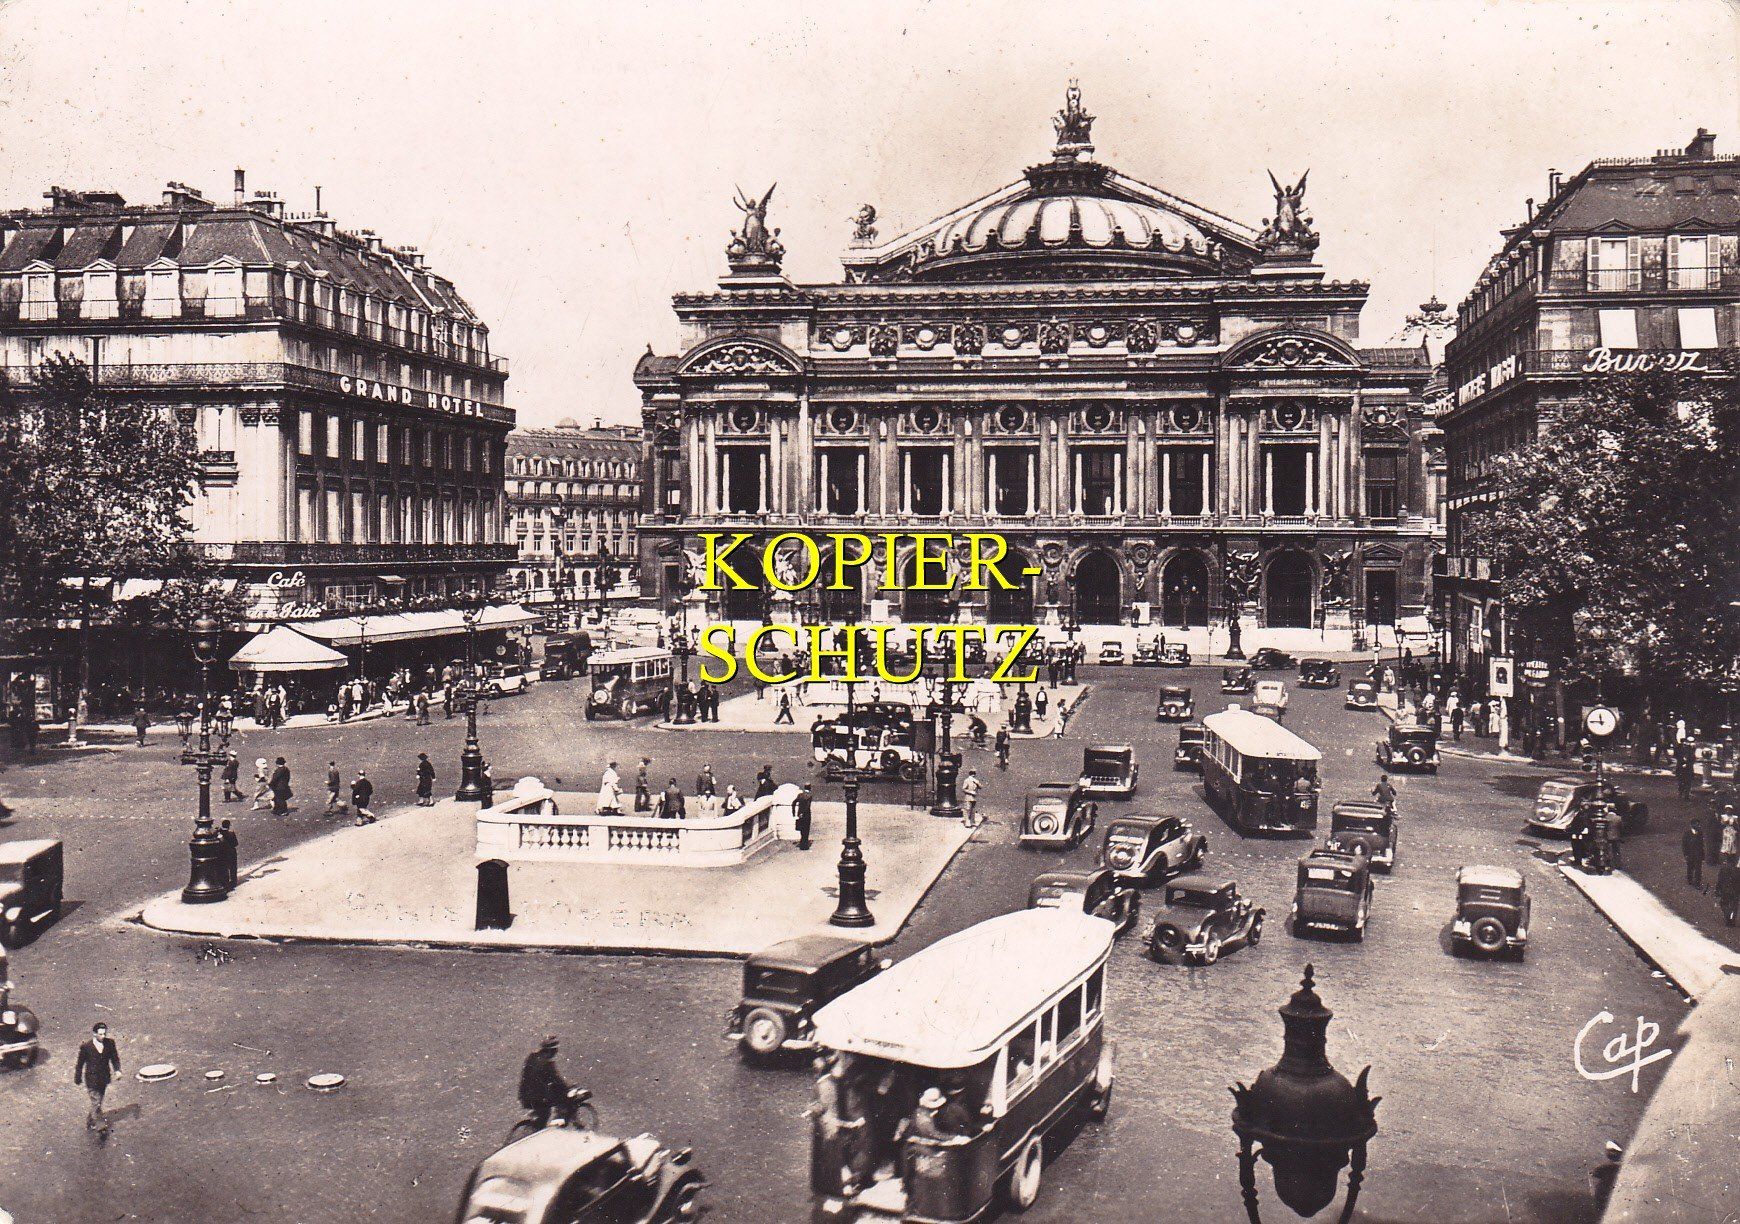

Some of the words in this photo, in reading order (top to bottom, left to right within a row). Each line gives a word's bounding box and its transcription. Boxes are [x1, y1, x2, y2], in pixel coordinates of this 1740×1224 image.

[339, 376, 413, 404] GRAND
[427, 393, 484, 418] HOTEL
[267, 571, 306, 588] Café
